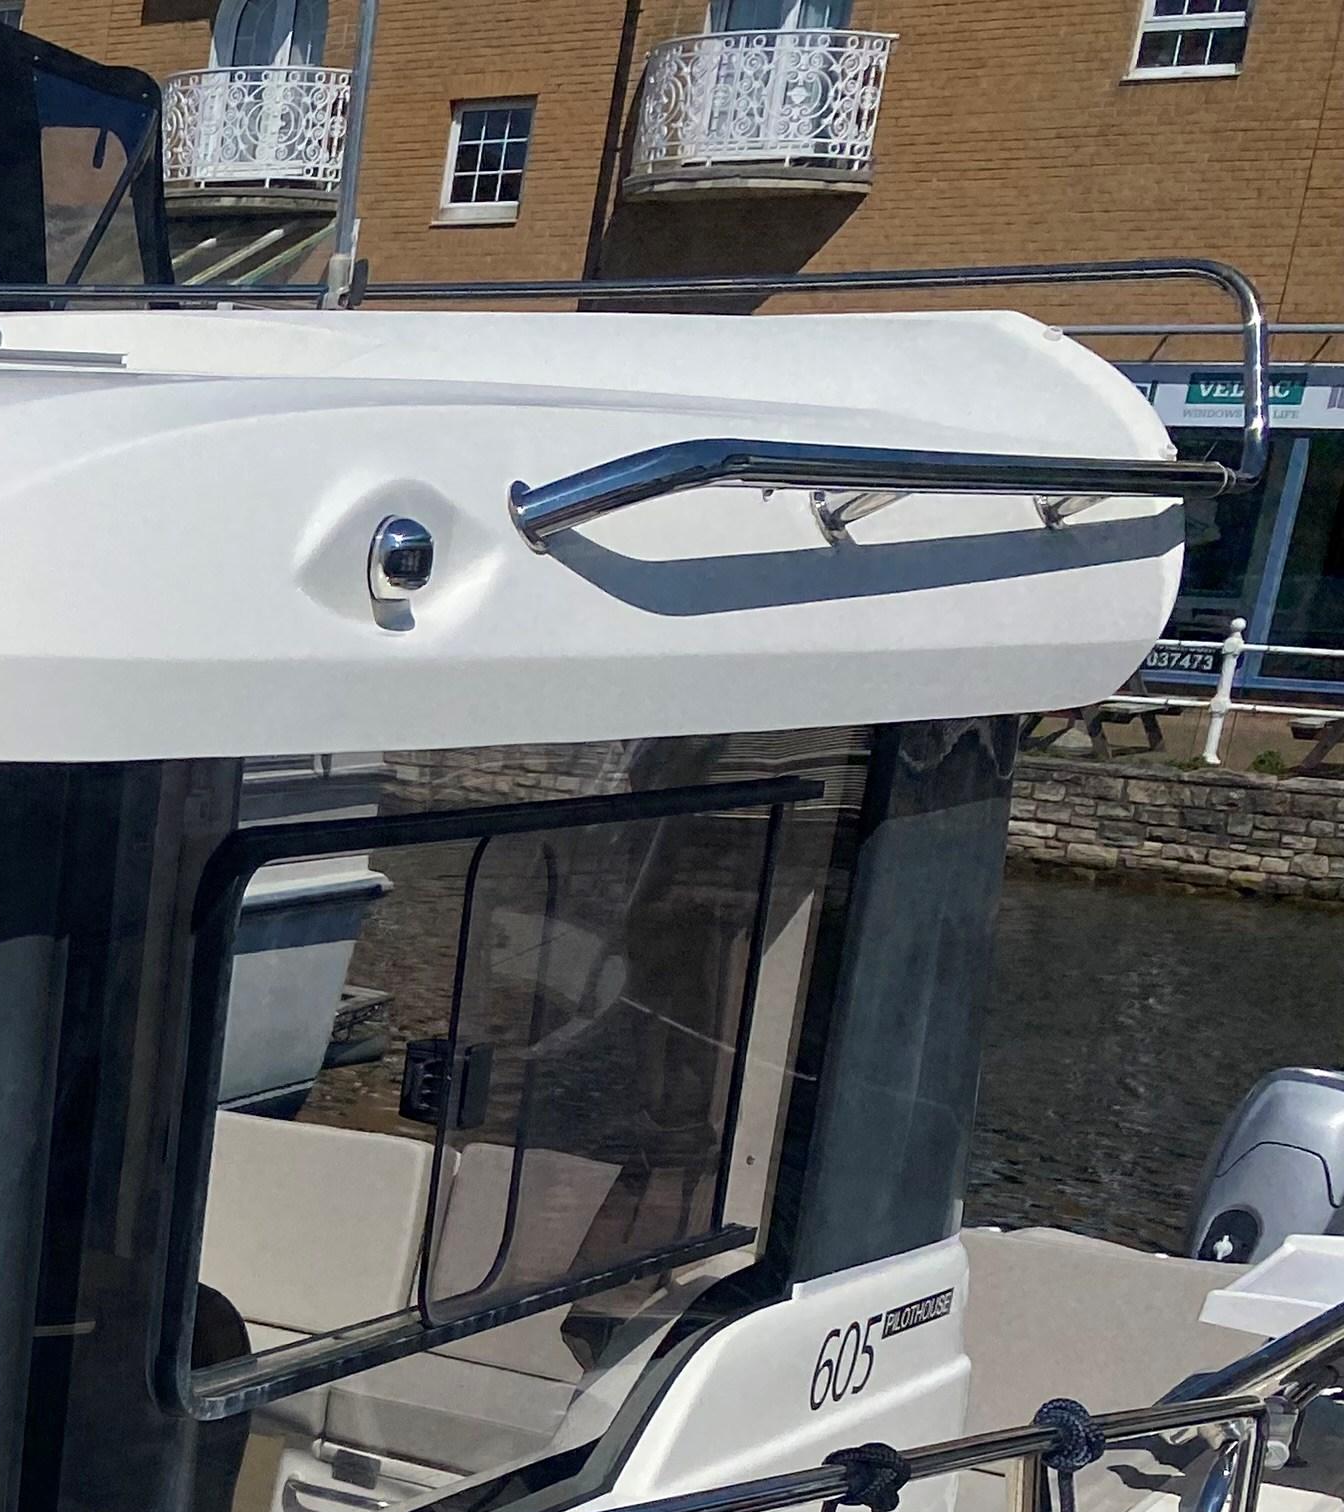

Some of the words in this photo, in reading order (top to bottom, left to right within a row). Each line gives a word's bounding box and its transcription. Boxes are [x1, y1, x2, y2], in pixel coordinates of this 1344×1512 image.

[1199, 380, 1291, 398] VELC
[1272, 410, 1300, 420] LIFE
[810, 1313, 883, 1411] 605
[885, 1292, 952, 1335] PILOTHOUSE
